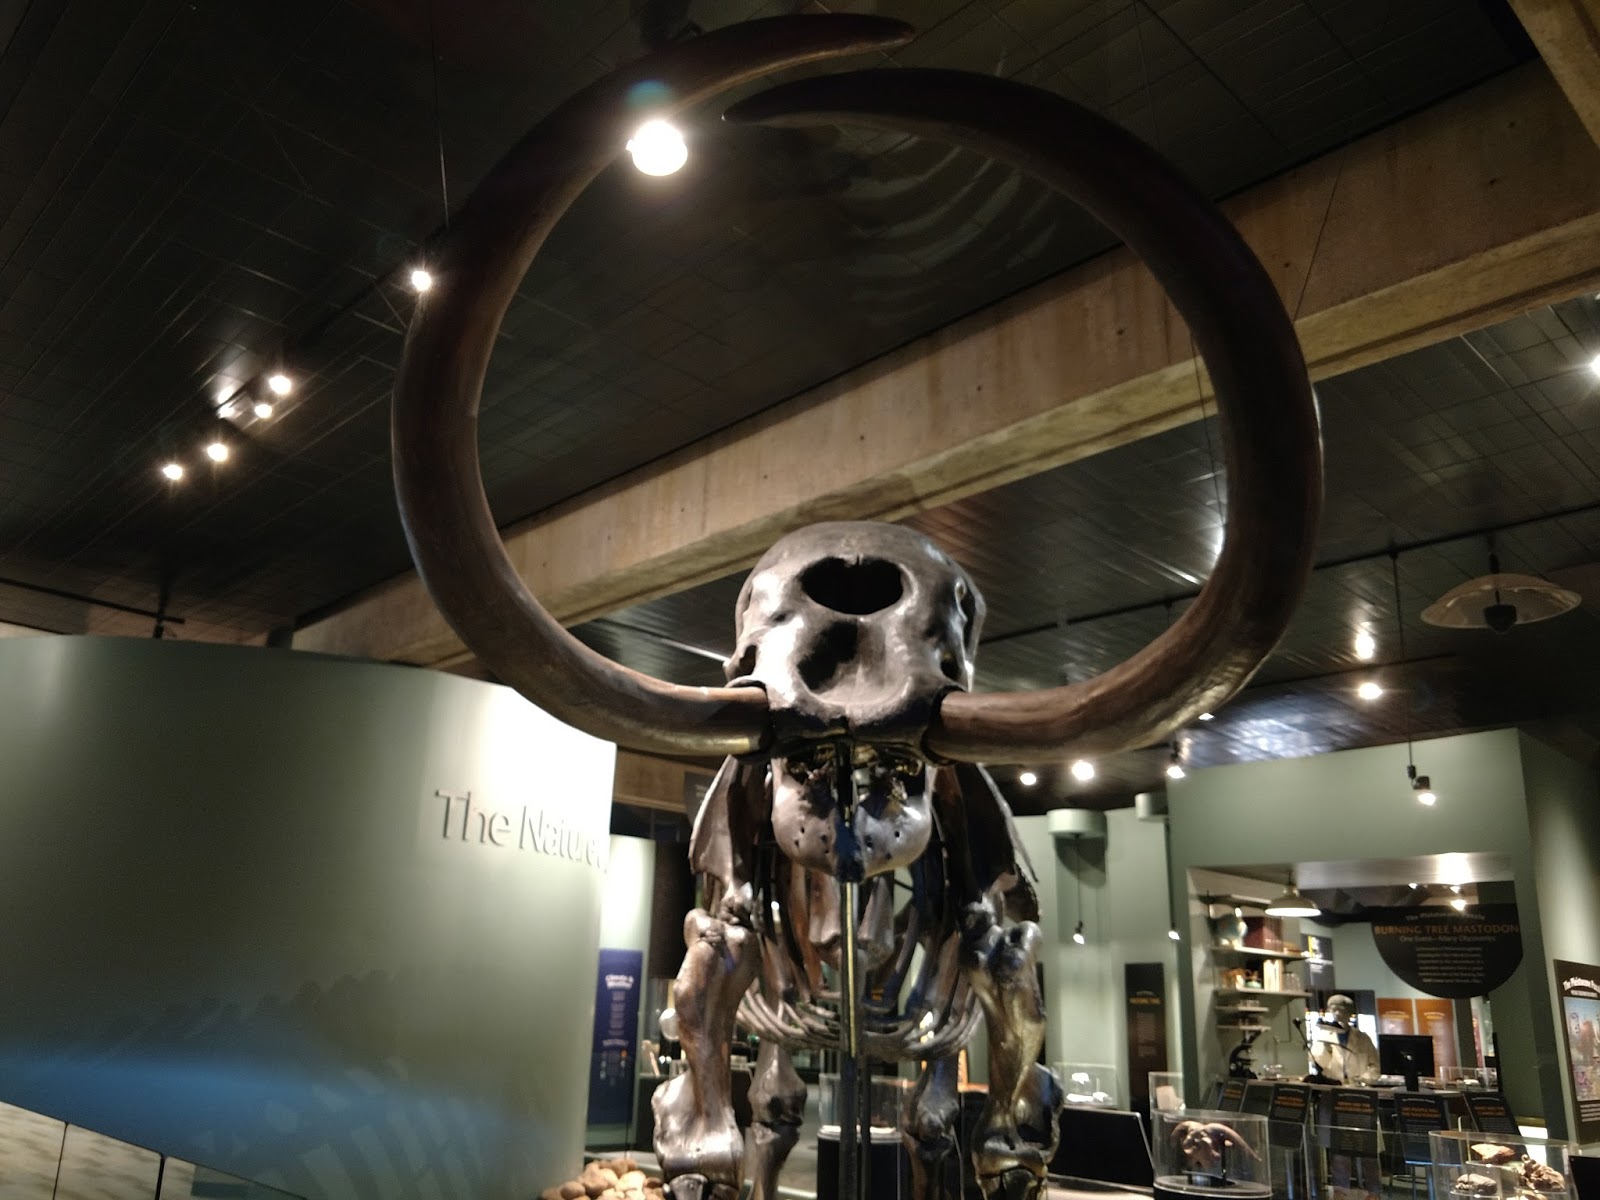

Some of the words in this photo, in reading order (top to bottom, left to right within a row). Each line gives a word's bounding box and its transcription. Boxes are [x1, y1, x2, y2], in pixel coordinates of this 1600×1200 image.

[435, 789, 511, 847] The
[1374, 925, 1422, 935] BURNING
[1425, 924, 1450, 934] TREE
[1453, 924, 1520, 934] MASTODON
